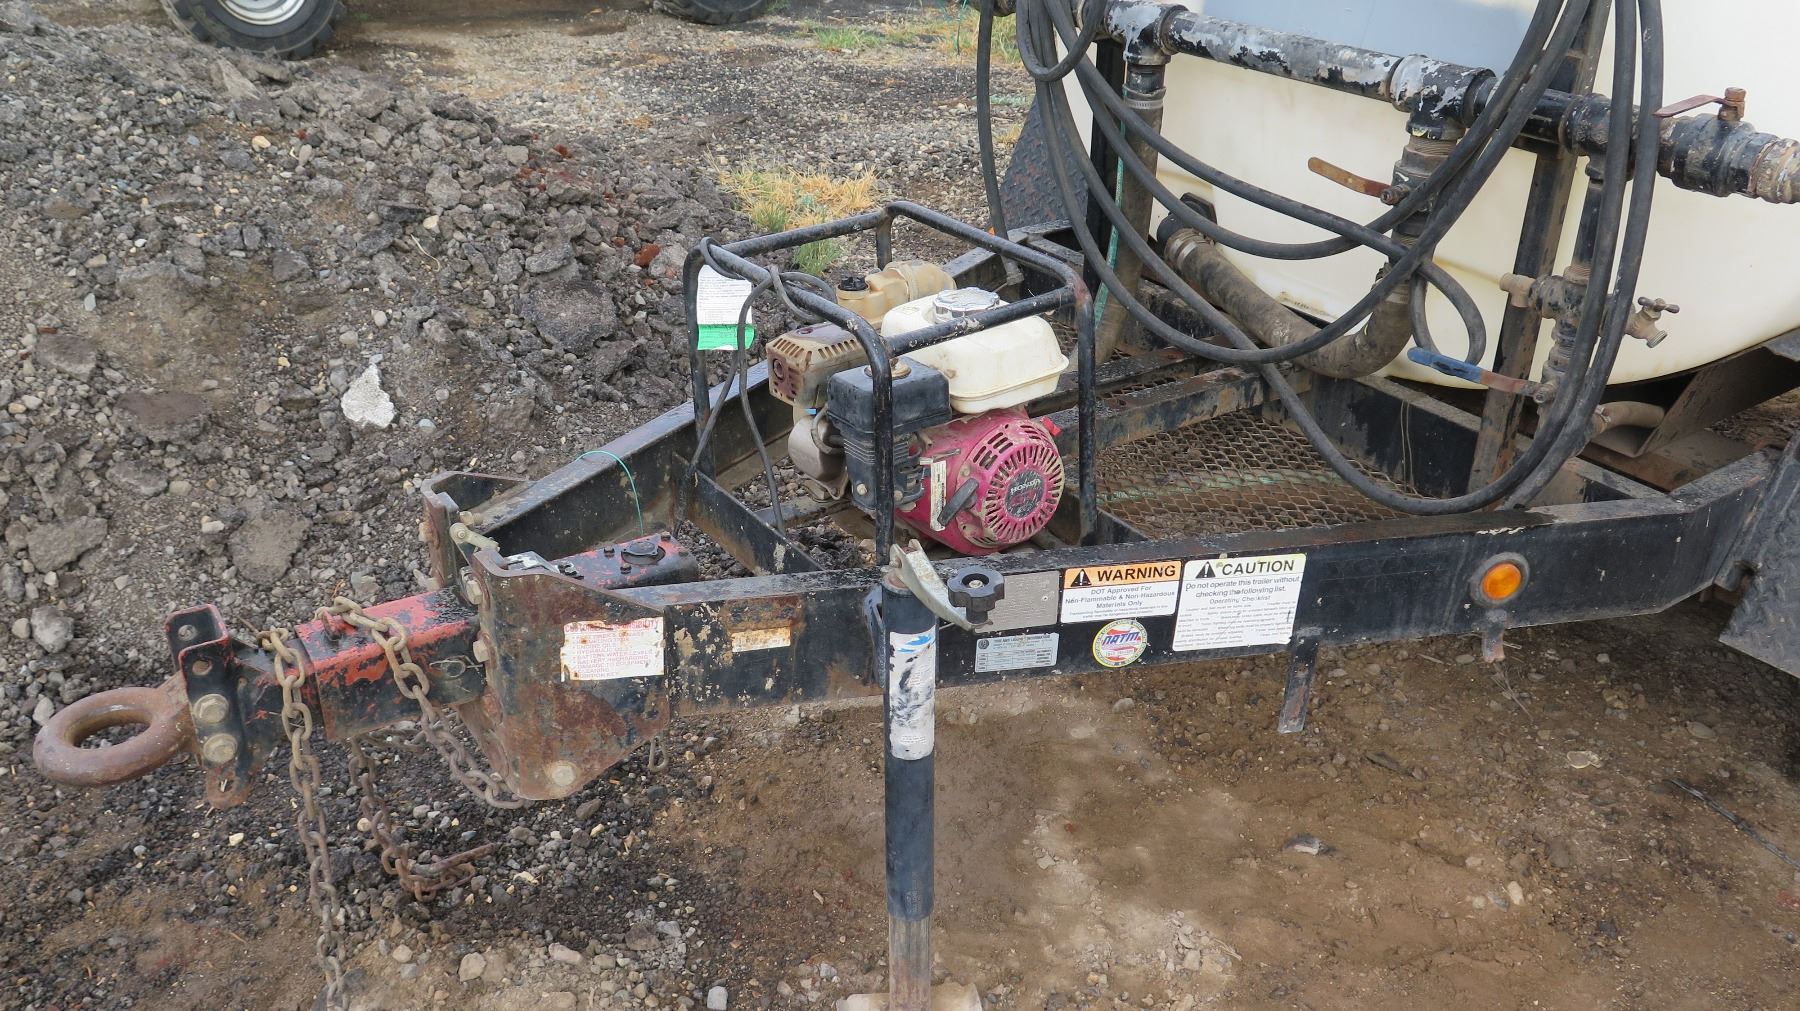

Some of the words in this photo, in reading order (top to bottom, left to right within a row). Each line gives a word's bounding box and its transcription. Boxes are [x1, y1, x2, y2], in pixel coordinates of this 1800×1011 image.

[1010, 478, 1041, 495] HONDA
[1097, 565, 1176, 581] WARNING
[1222, 560, 1294, 575] CAUTION
[1186, 583, 1196, 591] Do
[1210, 580, 1237, 590] operate
[1252, 577, 1273, 585] trailer
[1107, 587, 1139, 595] Approved
[1196, 589, 1228, 598] checking
[1241, 585, 1273, 595] following
[1065, 594, 1117, 604] Non-Flammable
[1096, 601, 1126, 609] Materials
[1128, 600, 1143, 608] Only
